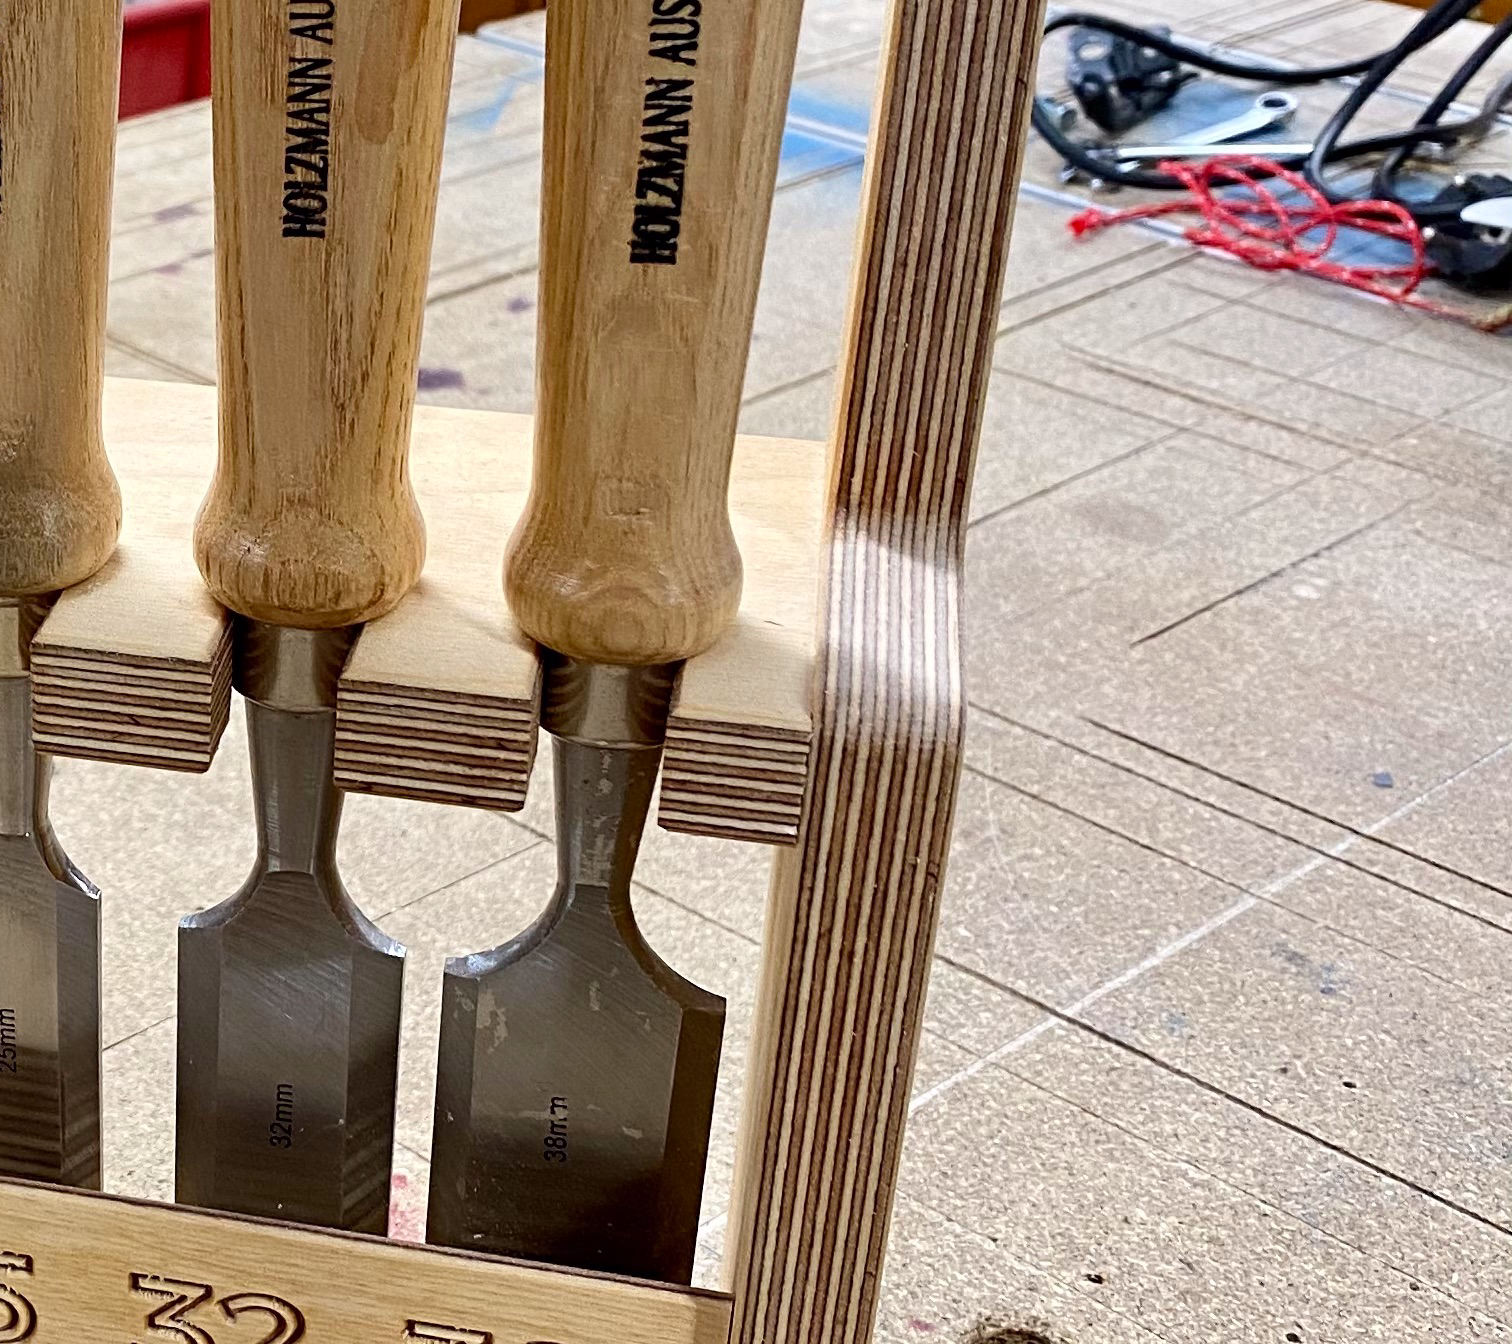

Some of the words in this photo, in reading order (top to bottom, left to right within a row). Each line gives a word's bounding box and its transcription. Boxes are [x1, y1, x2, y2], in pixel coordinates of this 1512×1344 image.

[281, 57, 333, 239] HOLZMANN
[629, 77, 696, 266] HOLZMANN
[269, 1083, 294, 1149] 32mm
